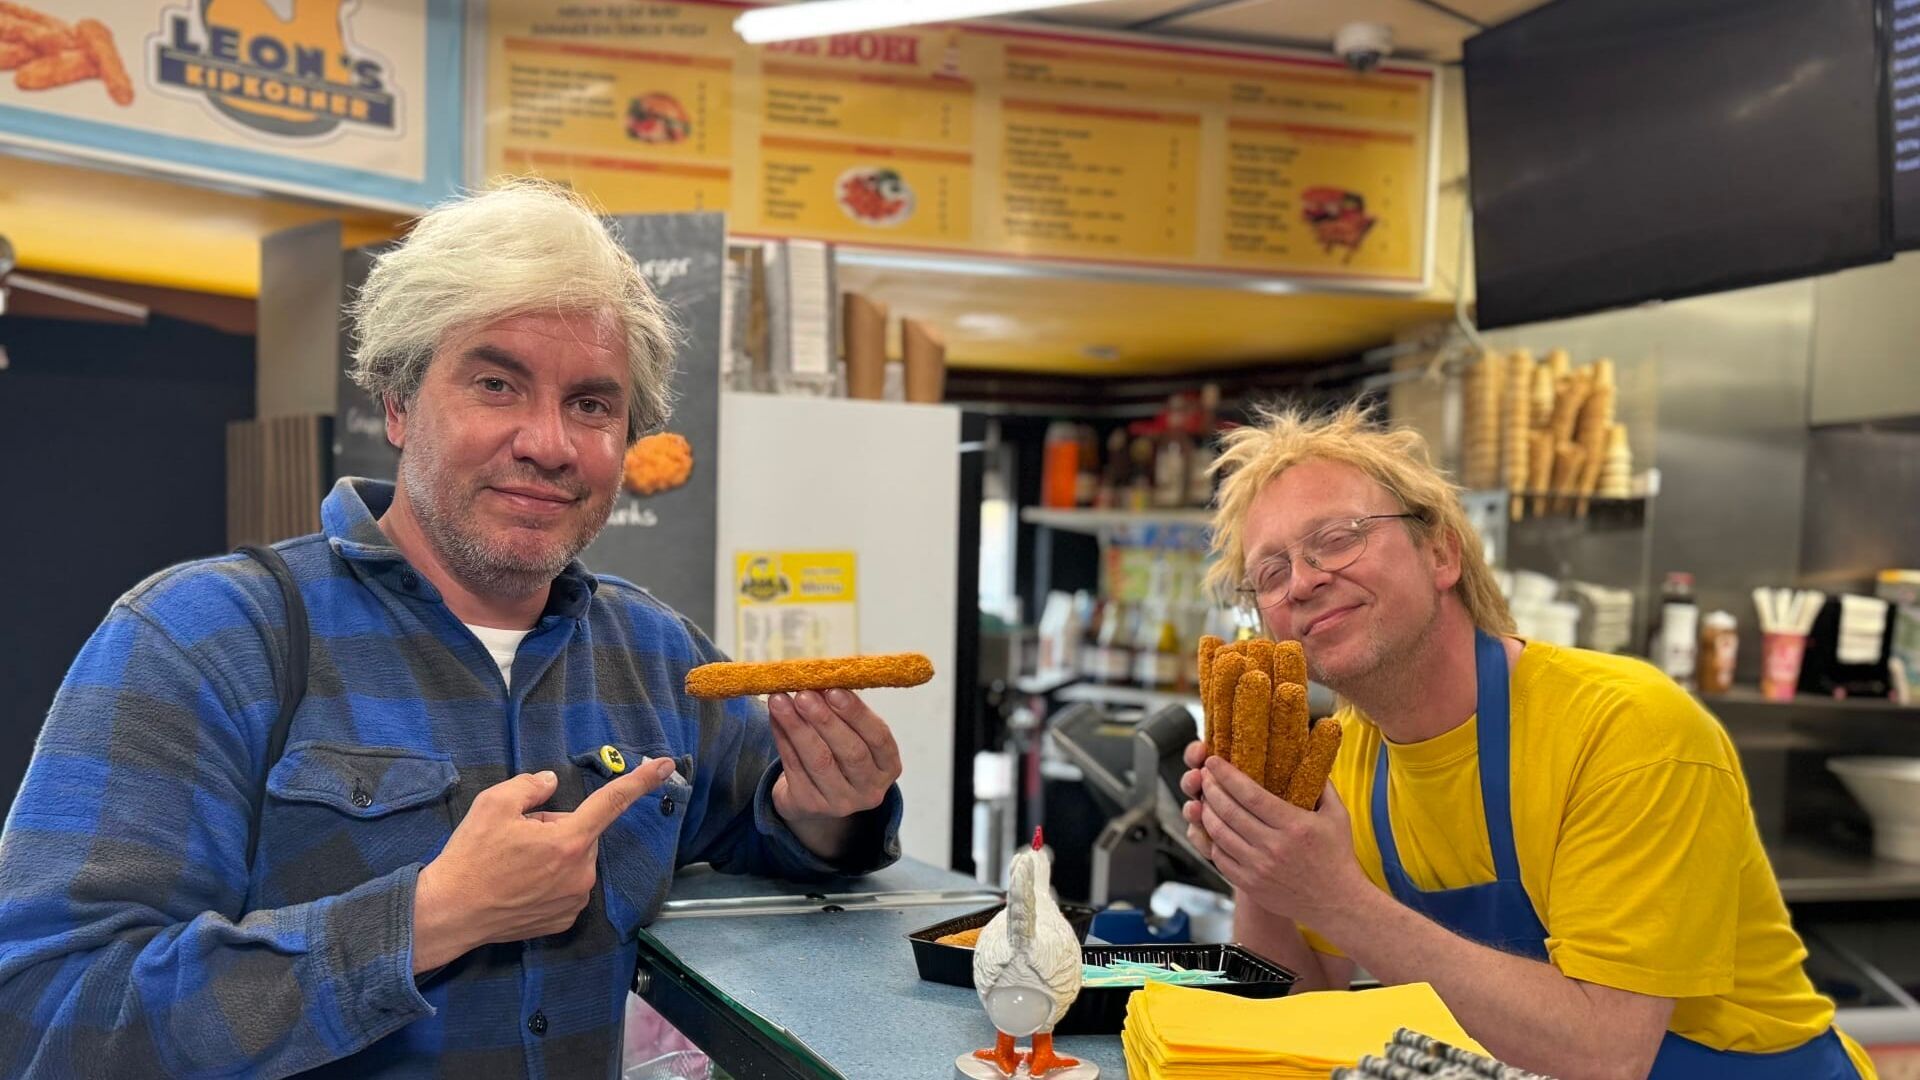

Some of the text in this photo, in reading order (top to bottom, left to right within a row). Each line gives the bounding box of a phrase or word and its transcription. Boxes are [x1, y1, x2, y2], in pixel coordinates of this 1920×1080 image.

[172, 14, 383, 92] LEON'S
[827, 32, 919, 65] BOEI
[184, 63, 369, 119] KIPKORNER
